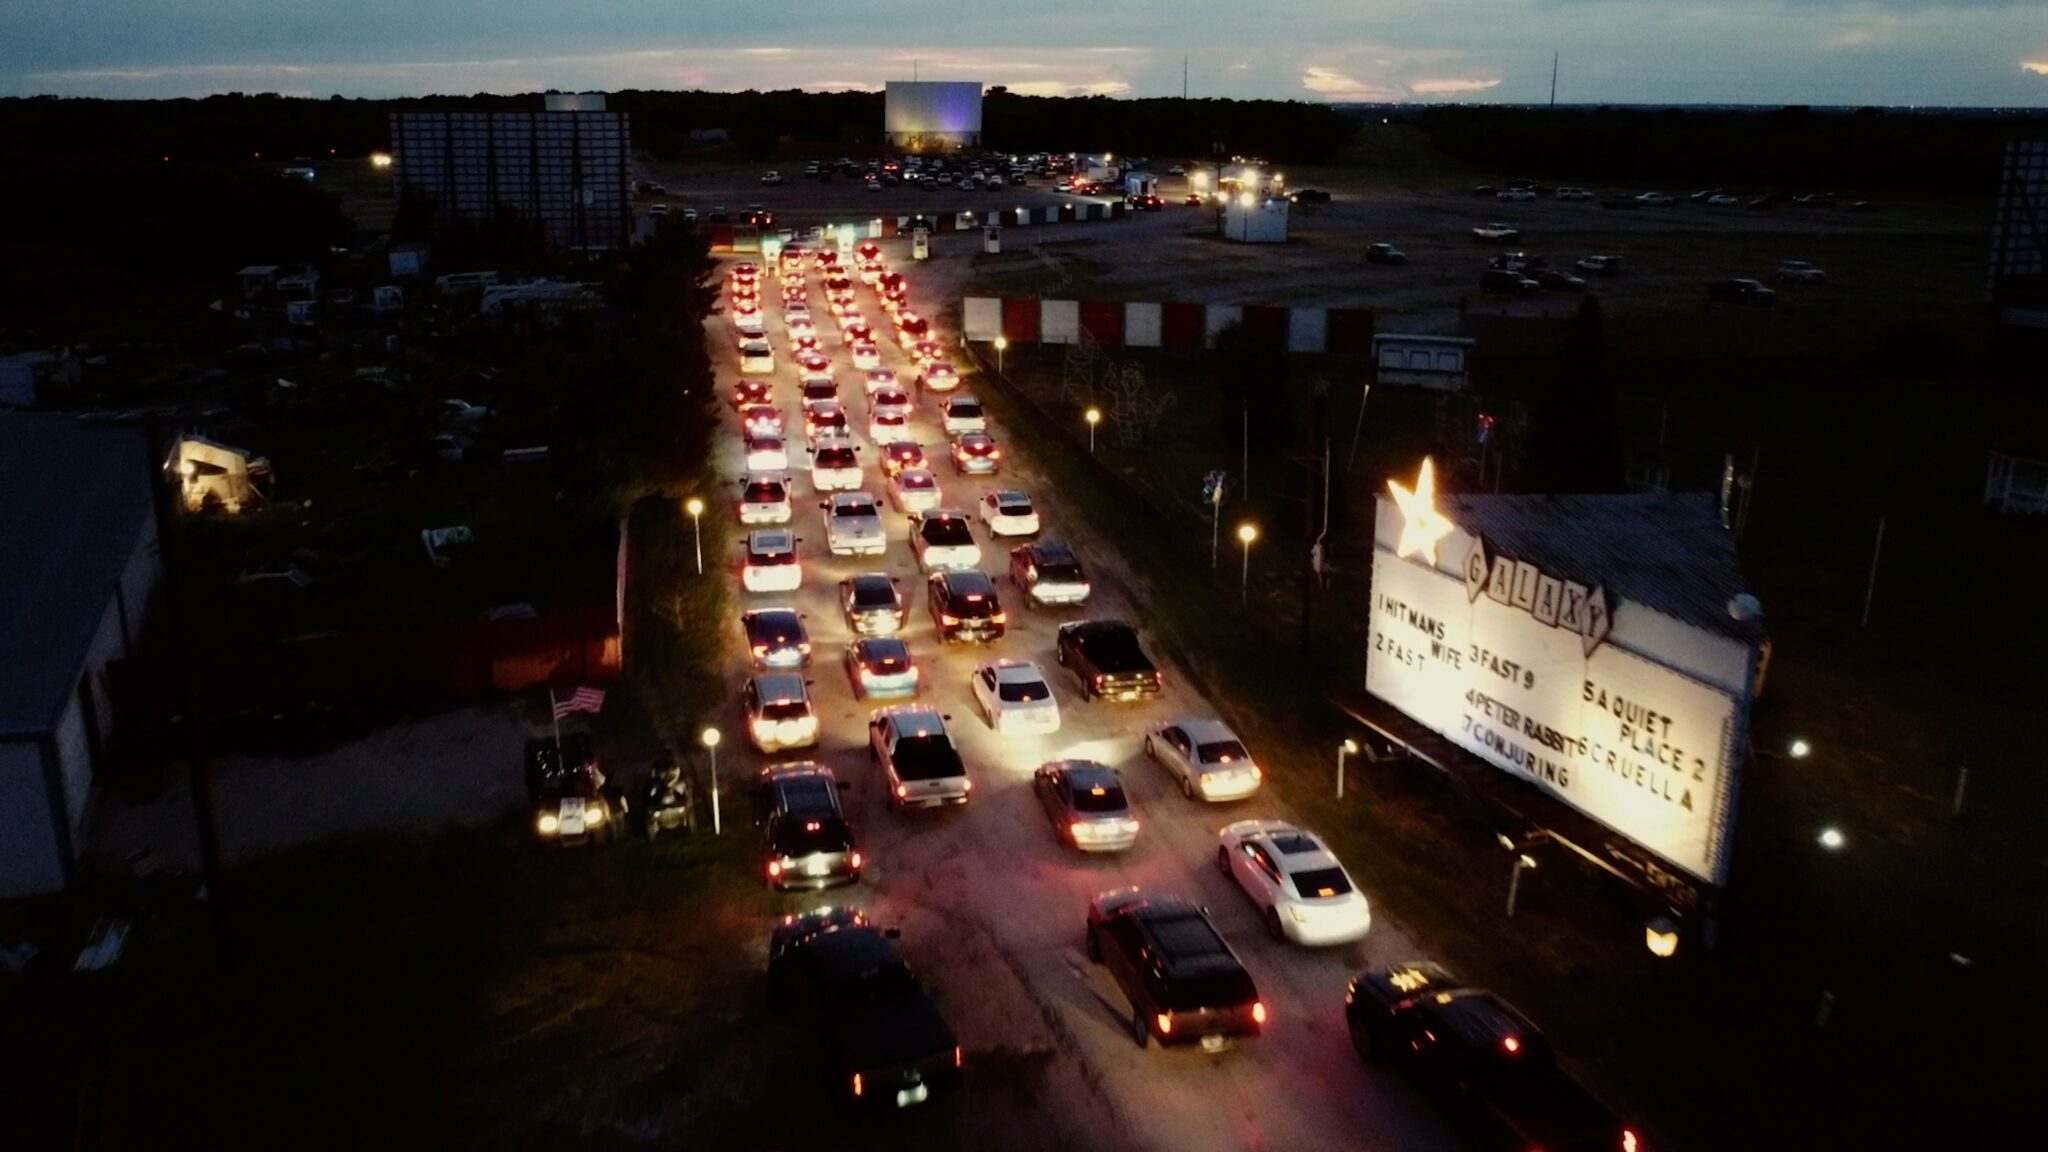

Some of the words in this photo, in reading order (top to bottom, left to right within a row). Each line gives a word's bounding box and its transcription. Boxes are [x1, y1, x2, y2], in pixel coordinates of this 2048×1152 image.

[1470, 554, 1603, 638] GALAXY
[1387, 639, 1425, 672] FAST
[1431, 640, 1463, 671] WIFE
[1522, 669, 1535, 690] 9
[1612, 696, 1673, 740] QUIET
[1619, 722, 1683, 772] PLACE
[1692, 758, 1706, 783] 2
